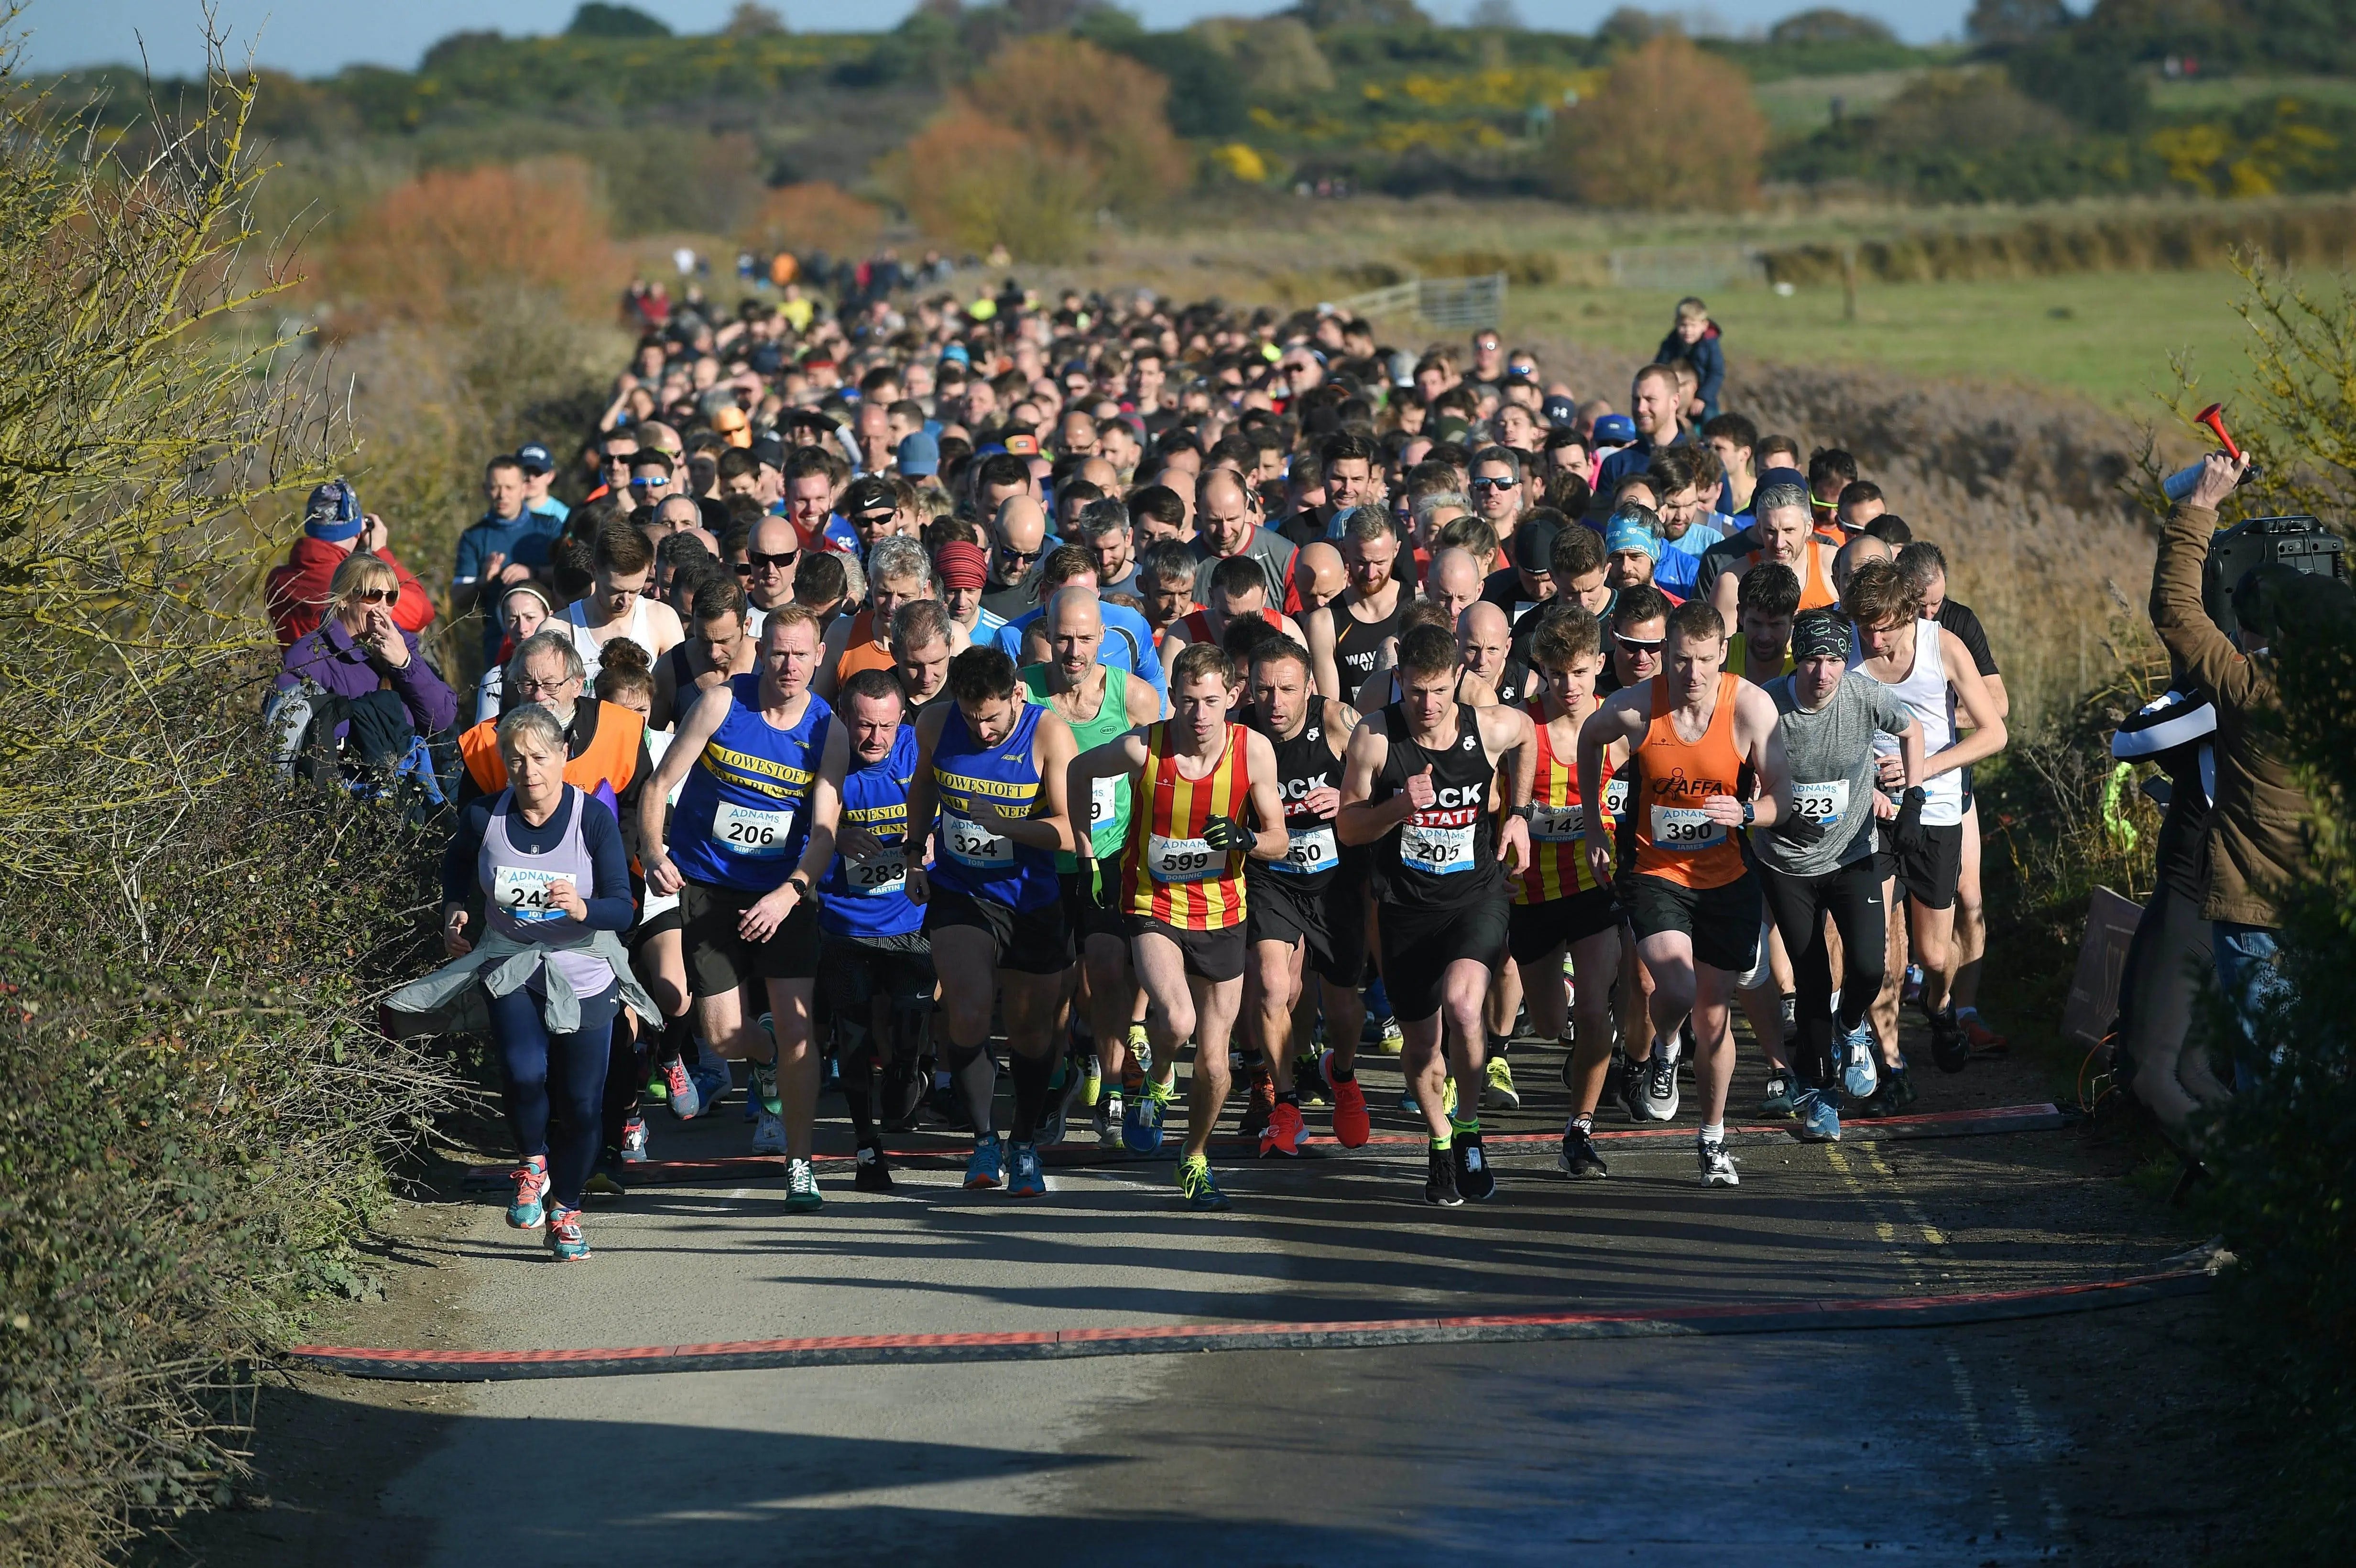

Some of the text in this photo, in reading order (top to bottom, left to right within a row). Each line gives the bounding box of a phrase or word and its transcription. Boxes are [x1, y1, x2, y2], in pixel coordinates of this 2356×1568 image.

[721, 750, 809, 783] LOWESTOFT
[938, 771, 1024, 797] LOWESTOFT
[1277, 772, 1329, 800] OCK
[1653, 773, 1723, 797] JAFFA
[846, 805, 907, 820] OWESTO
[1543, 806, 1582, 815] ADNAM
[1662, 810, 1707, 819] ADNAM
[1792, 797, 1833, 815] 523
[727, 822, 774, 845] 206
[869, 824, 907, 834] RUNN
[951, 820, 986, 832] ADNA
[1545, 817, 1584, 833] 142
[1667, 823, 1712, 841] 390
[733, 845, 761, 854] SIMON
[954, 834, 997, 857] 324
[1160, 840, 1211, 849] ADNAM
[1287, 844, 1321, 862] 50
[1417, 843, 1461, 862] 205
[967, 859, 984, 867] TOM
[1162, 853, 1208, 871] 599
[508, 871, 555, 883] ADNAM
[860, 863, 905, 884] 283
[1166, 872, 1202, 881] DOMINIC
[869, 884, 901, 894] MARTIN
